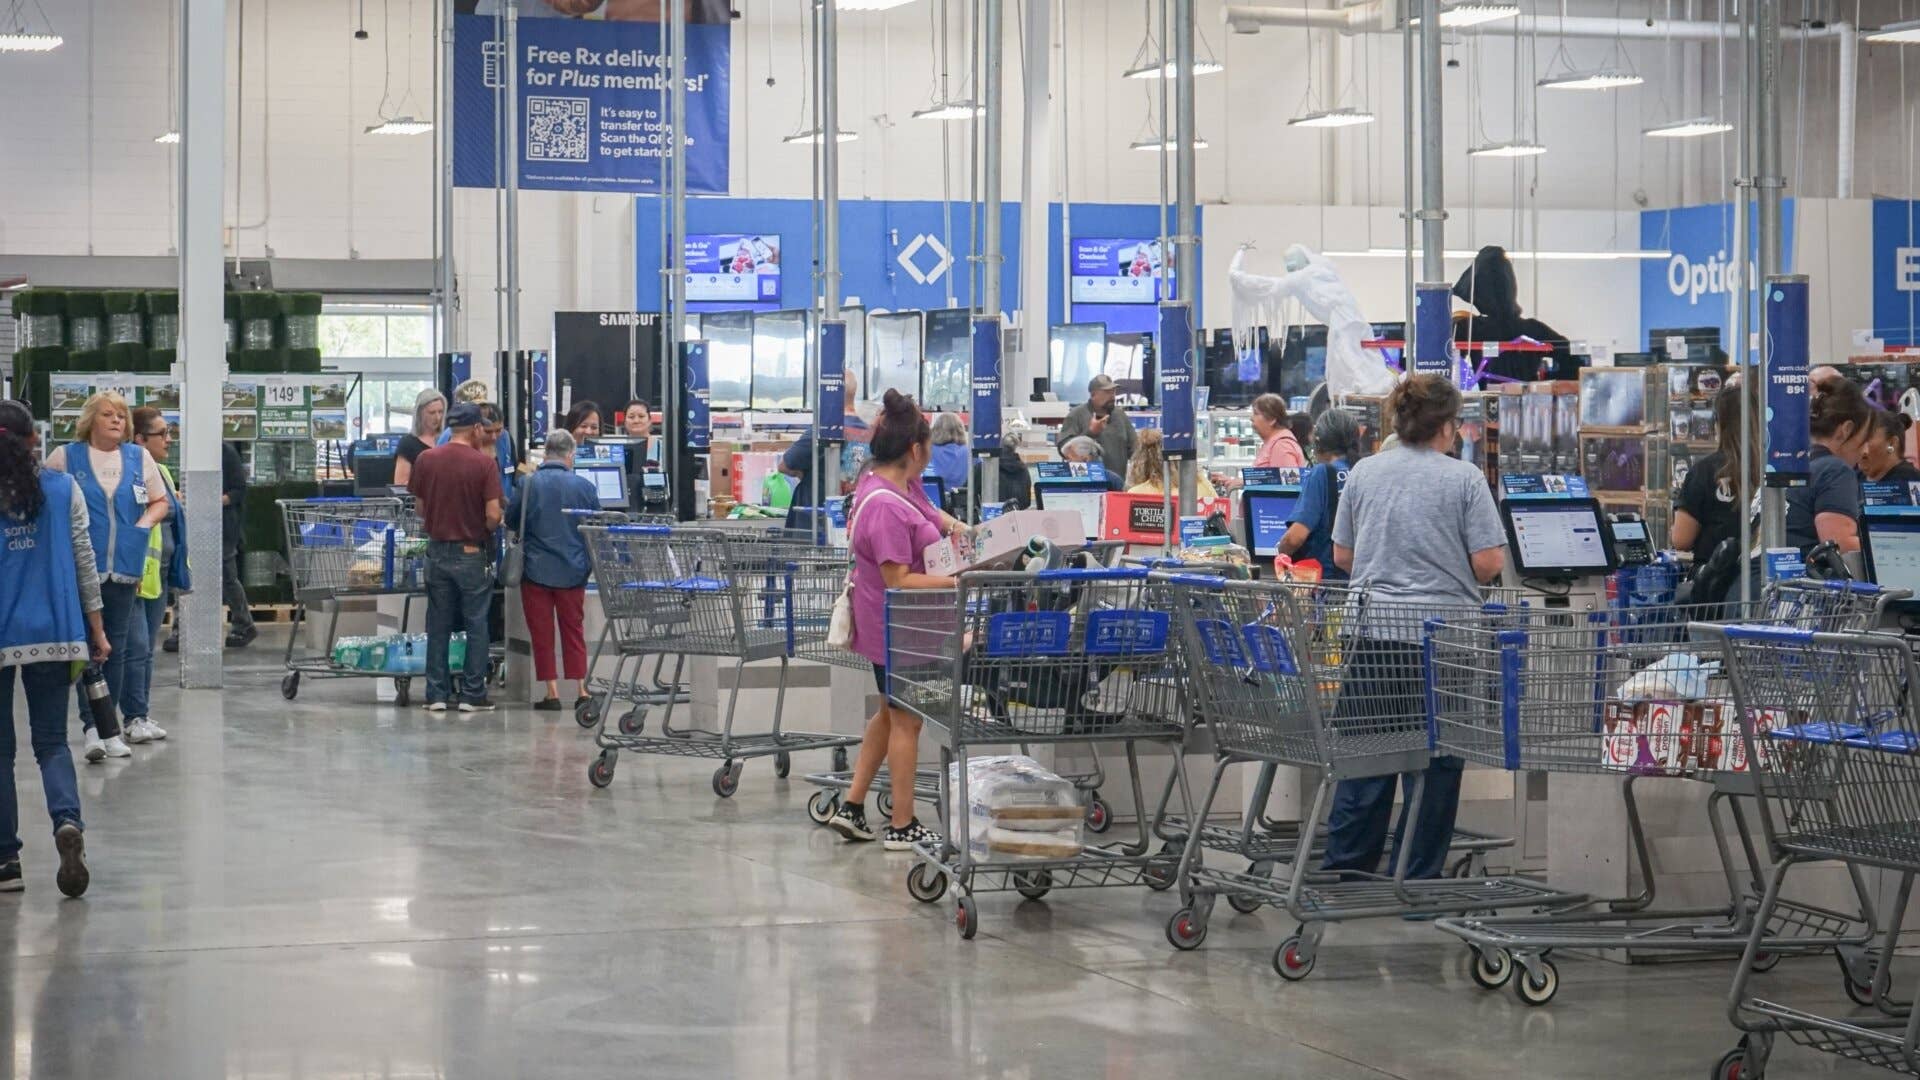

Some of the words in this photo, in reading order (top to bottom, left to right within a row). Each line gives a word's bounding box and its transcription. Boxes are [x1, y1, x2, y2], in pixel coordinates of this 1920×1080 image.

[527, 46, 571, 64] Free
[576, 48, 601, 66] Rx
[605, 50, 687, 69] deliver
[526, 68, 555, 85] for
[560, 69, 600, 87] Plus
[604, 73, 709, 92] membs!
[601, 106, 616, 117] It's
[618, 109, 643, 120] easy
[645, 109, 657, 119] to
[600, 121, 642, 131] transfer
[644, 122, 672, 134] tody
[600, 132, 626, 143] Scan
[628, 134, 646, 143] the
[667, 135, 694, 145] ce
[600, 145, 611, 155] to
[614, 148, 632, 158] get
[634, 147, 673, 157] startd
[1668, 249, 1758, 304] Optic
[600, 313, 660, 326] SAMSU
[1133, 507, 1165, 516] TORTIL
